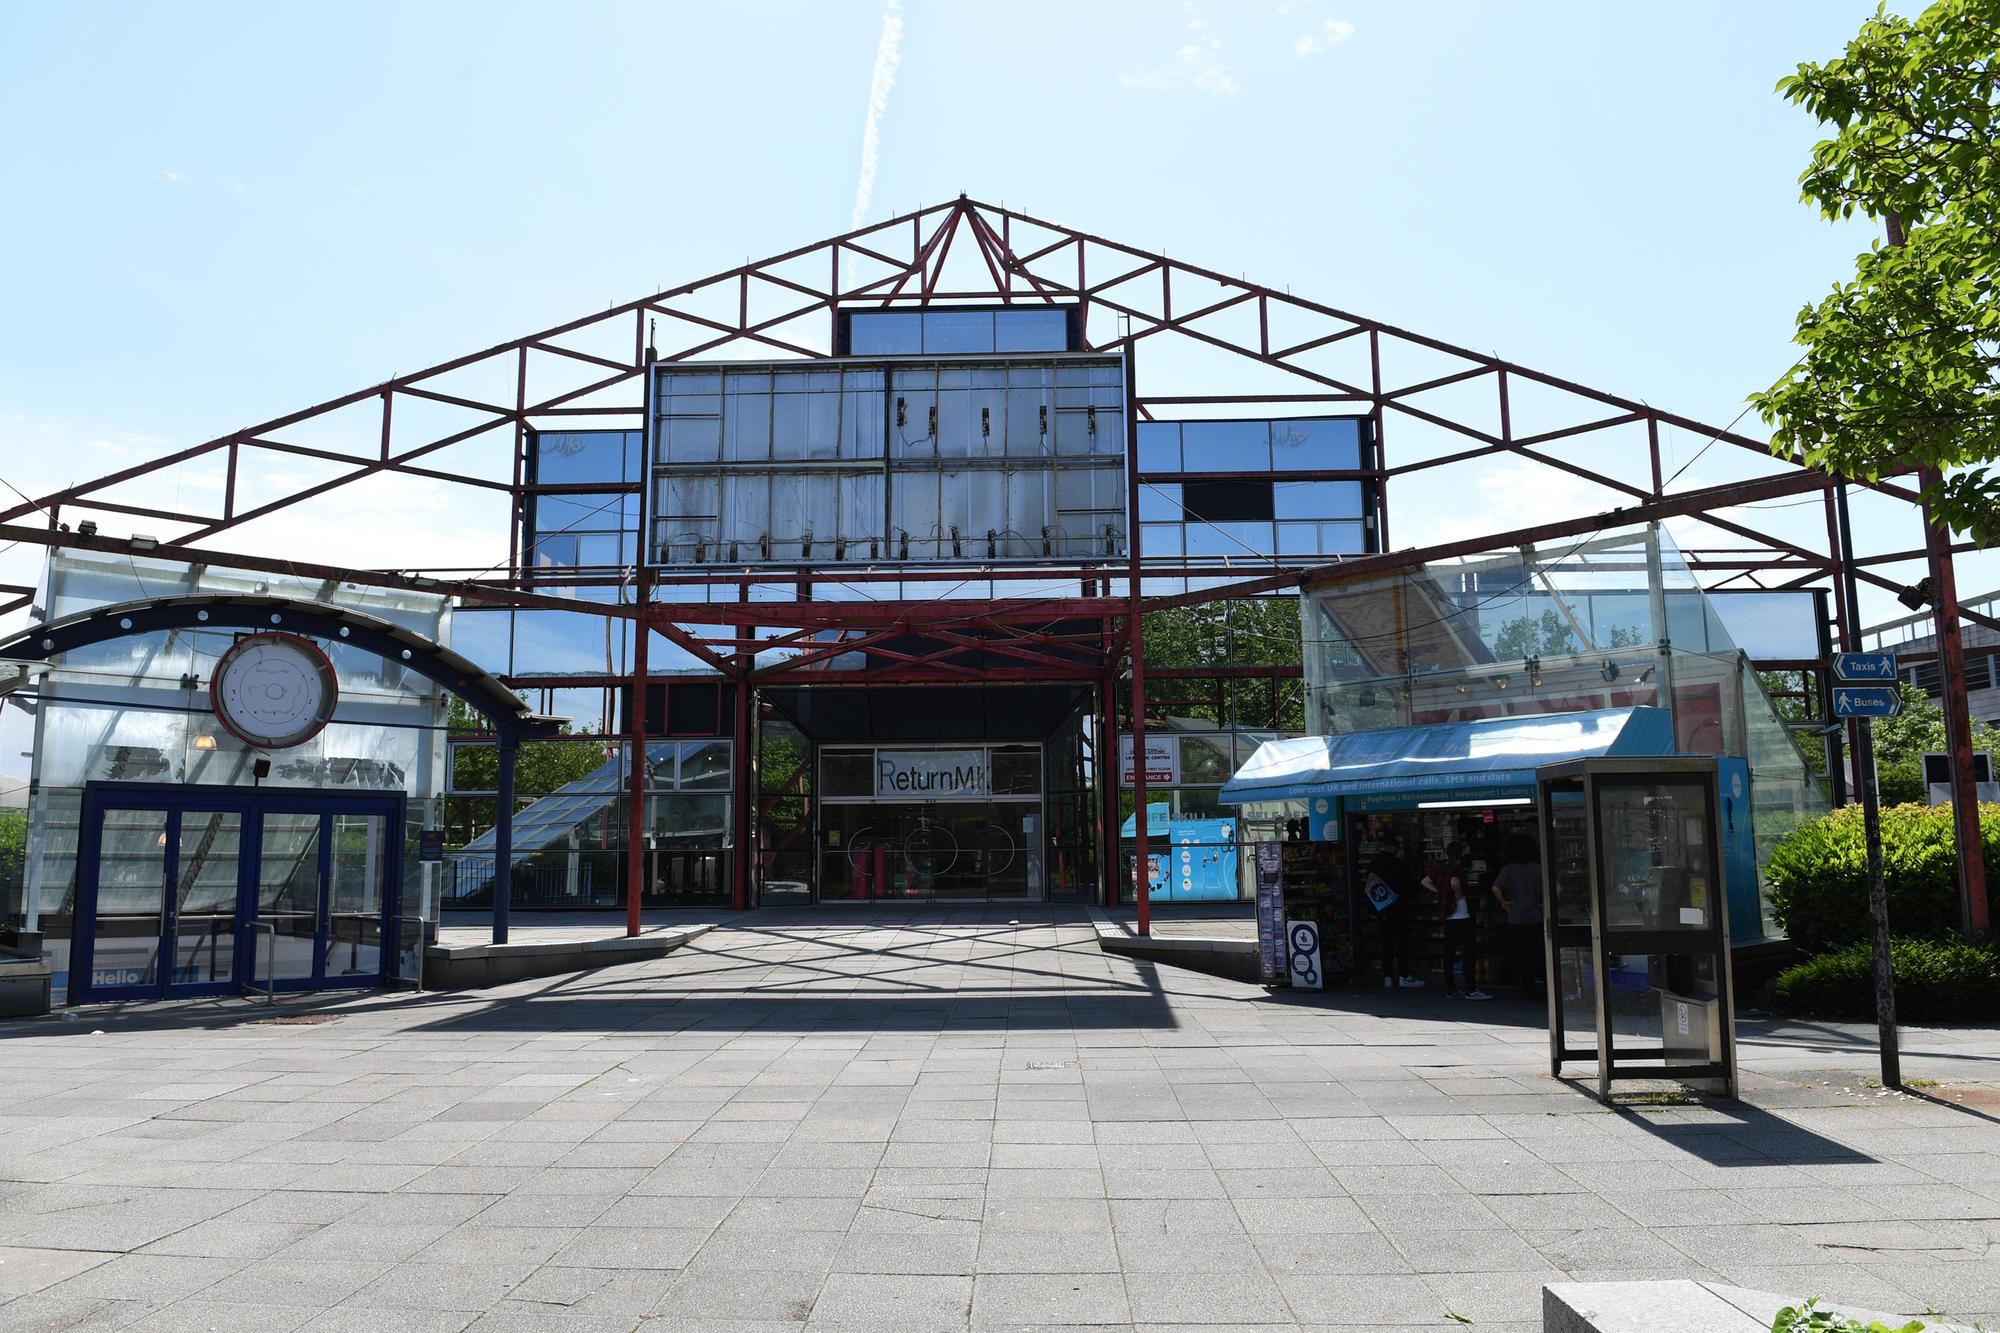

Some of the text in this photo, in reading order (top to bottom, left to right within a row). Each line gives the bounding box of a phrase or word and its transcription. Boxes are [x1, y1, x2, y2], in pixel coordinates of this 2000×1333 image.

[1849, 661, 1876, 671] Taxis
[1854, 697, 1885, 707] Buses
[1307, 785, 1325, 793] cost
[1327, 783, 1339, 793] UK
[1341, 782, 1357, 791] and
[1444, 774, 1465, 784] SMS
[1467, 773, 1486, 783] and
[1488, 772, 1511, 782] data
[92, 969, 139, 985] Hello
